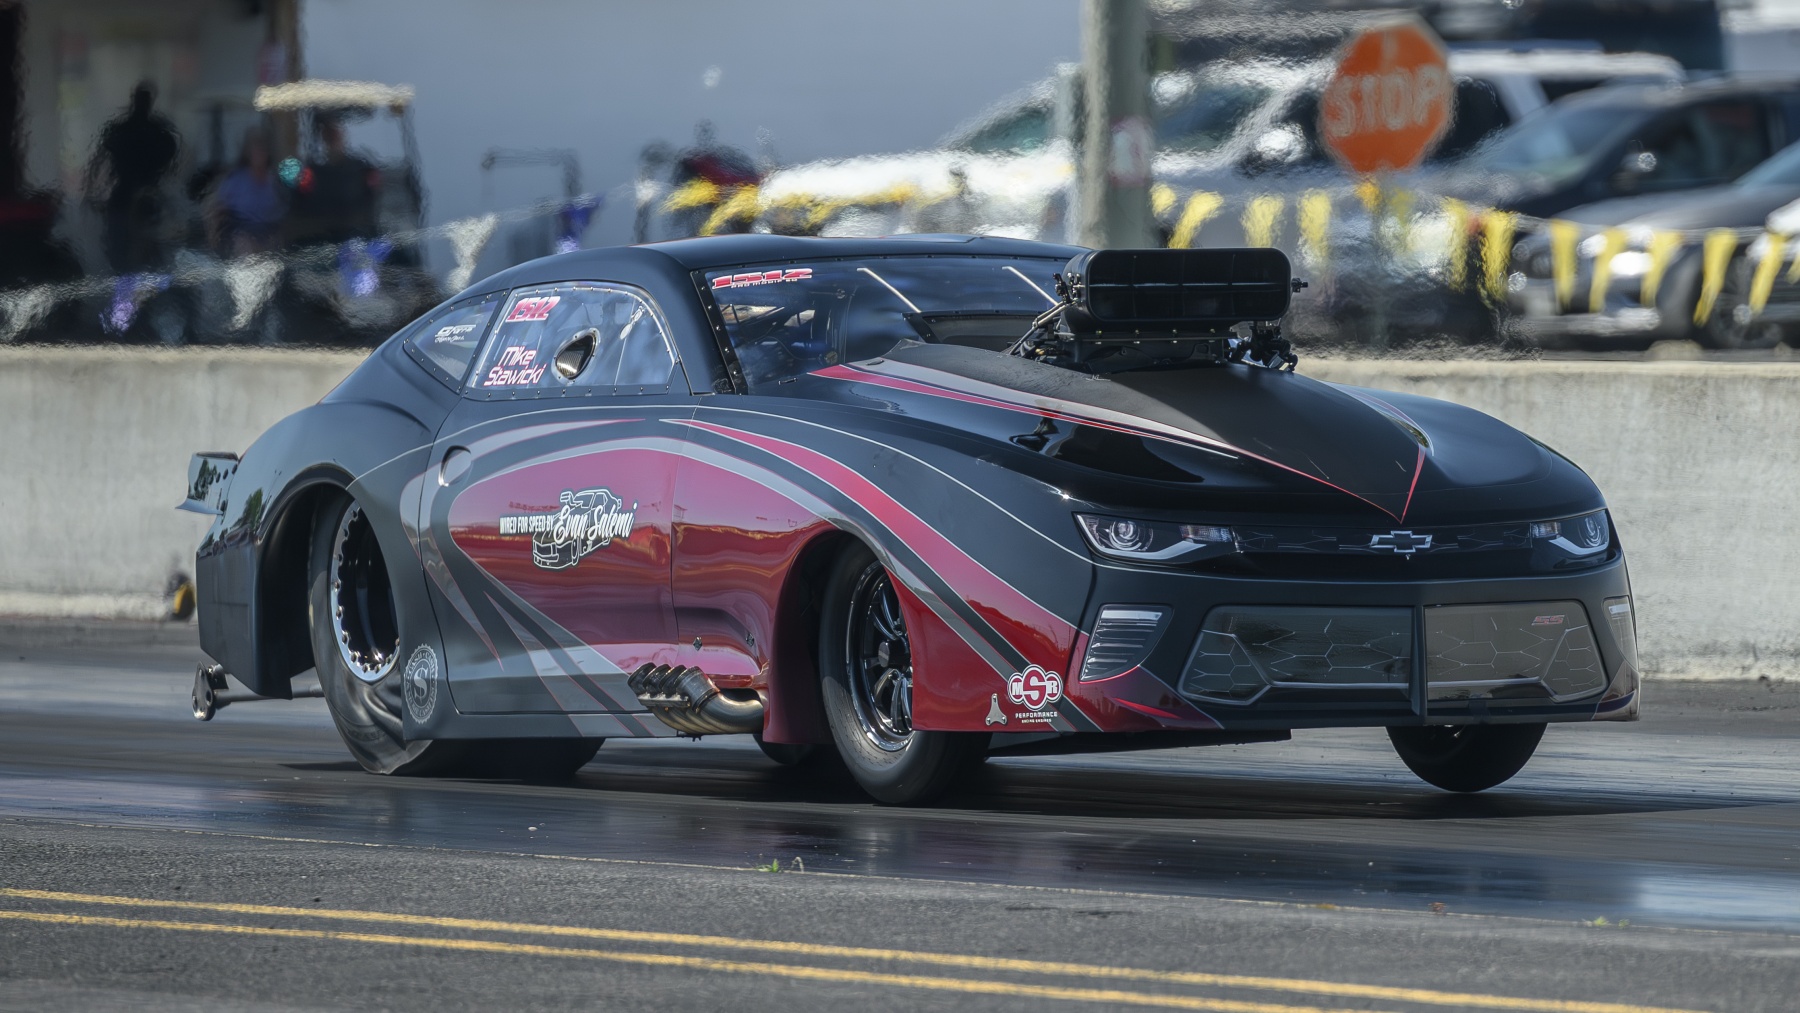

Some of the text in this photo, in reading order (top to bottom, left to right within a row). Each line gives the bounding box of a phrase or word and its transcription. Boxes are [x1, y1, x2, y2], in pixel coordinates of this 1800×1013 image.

[1326, 64, 1443, 137] STOP
[712, 268, 812, 289] 1512
[505, 296, 561, 322] 1512
[497, 346, 537, 366] Mike
[483, 364, 547, 386] Stawicki
[518, 516, 529, 533] FOR
[529, 515, 546, 532] SPEED
[546, 514, 554, 531] BY
[553, 505, 588, 544] Evan
[587, 502, 638, 540] Salemi
